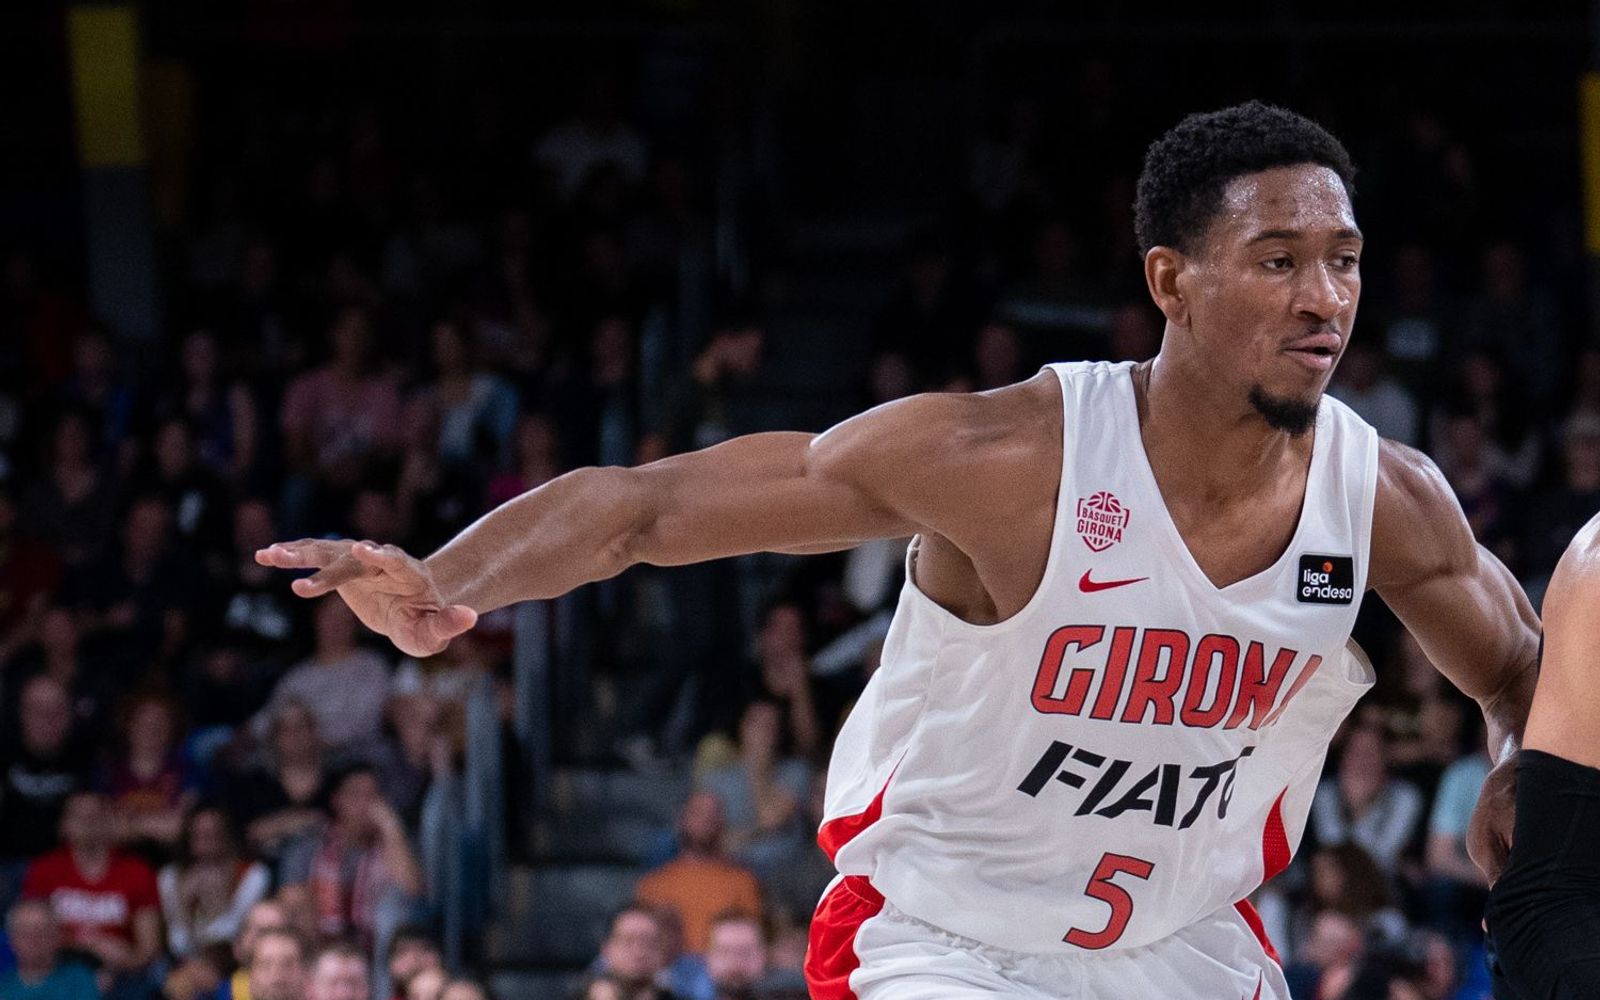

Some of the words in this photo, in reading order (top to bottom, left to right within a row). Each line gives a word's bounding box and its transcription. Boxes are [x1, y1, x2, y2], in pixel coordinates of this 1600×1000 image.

[1082, 508, 1123, 526] BASQUET
[1077, 519, 1122, 543] GIRONA
[1303, 569, 1329, 585] liga
[1302, 584, 1352, 599] endesa
[1062, 852, 1155, 950] 5
